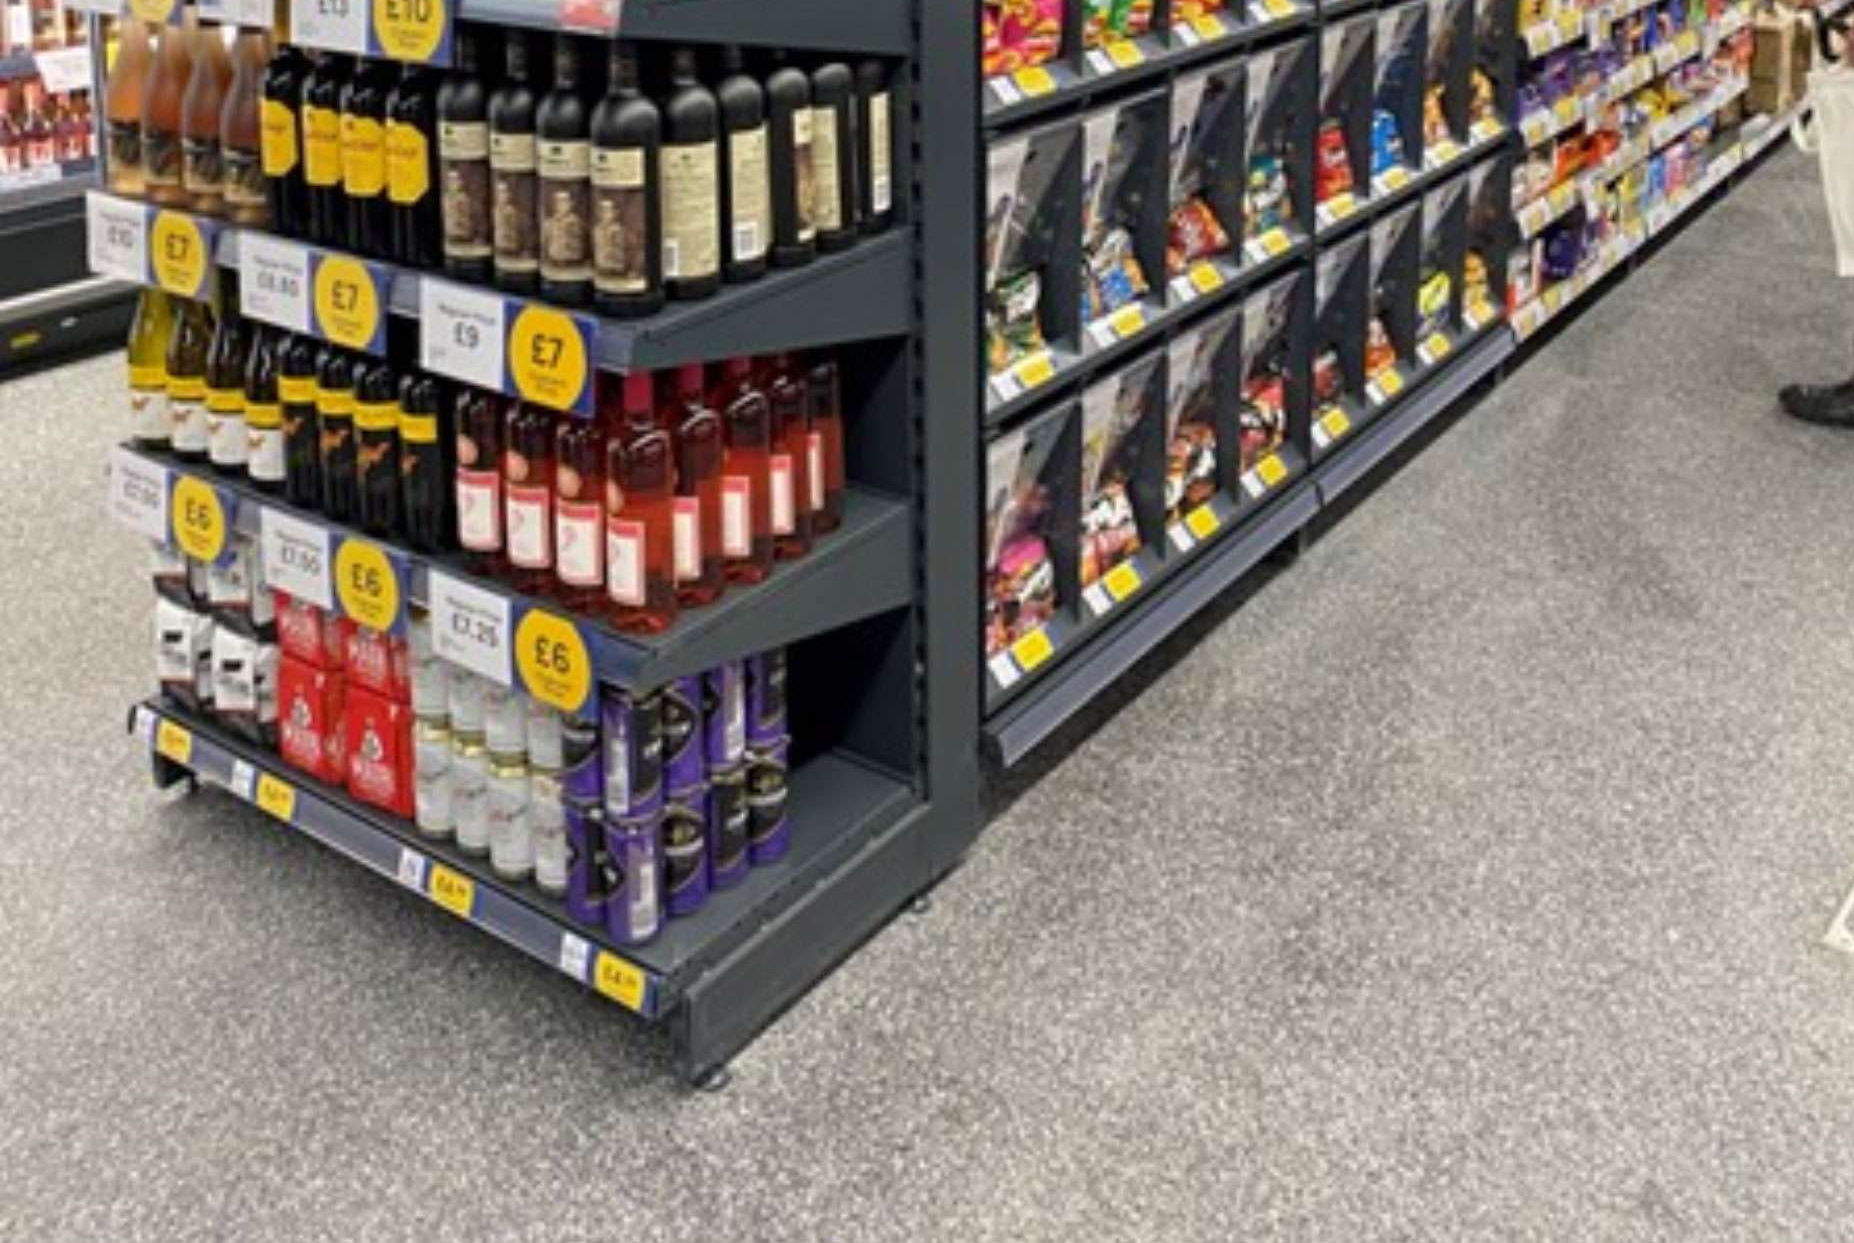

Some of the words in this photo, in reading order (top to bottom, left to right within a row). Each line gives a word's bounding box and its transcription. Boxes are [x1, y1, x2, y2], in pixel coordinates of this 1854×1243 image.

[331, 279, 359, 312] £7
[531, 332, 565, 369] £7
[350, 562, 383, 597] £6
[534, 634, 571, 674] £6
